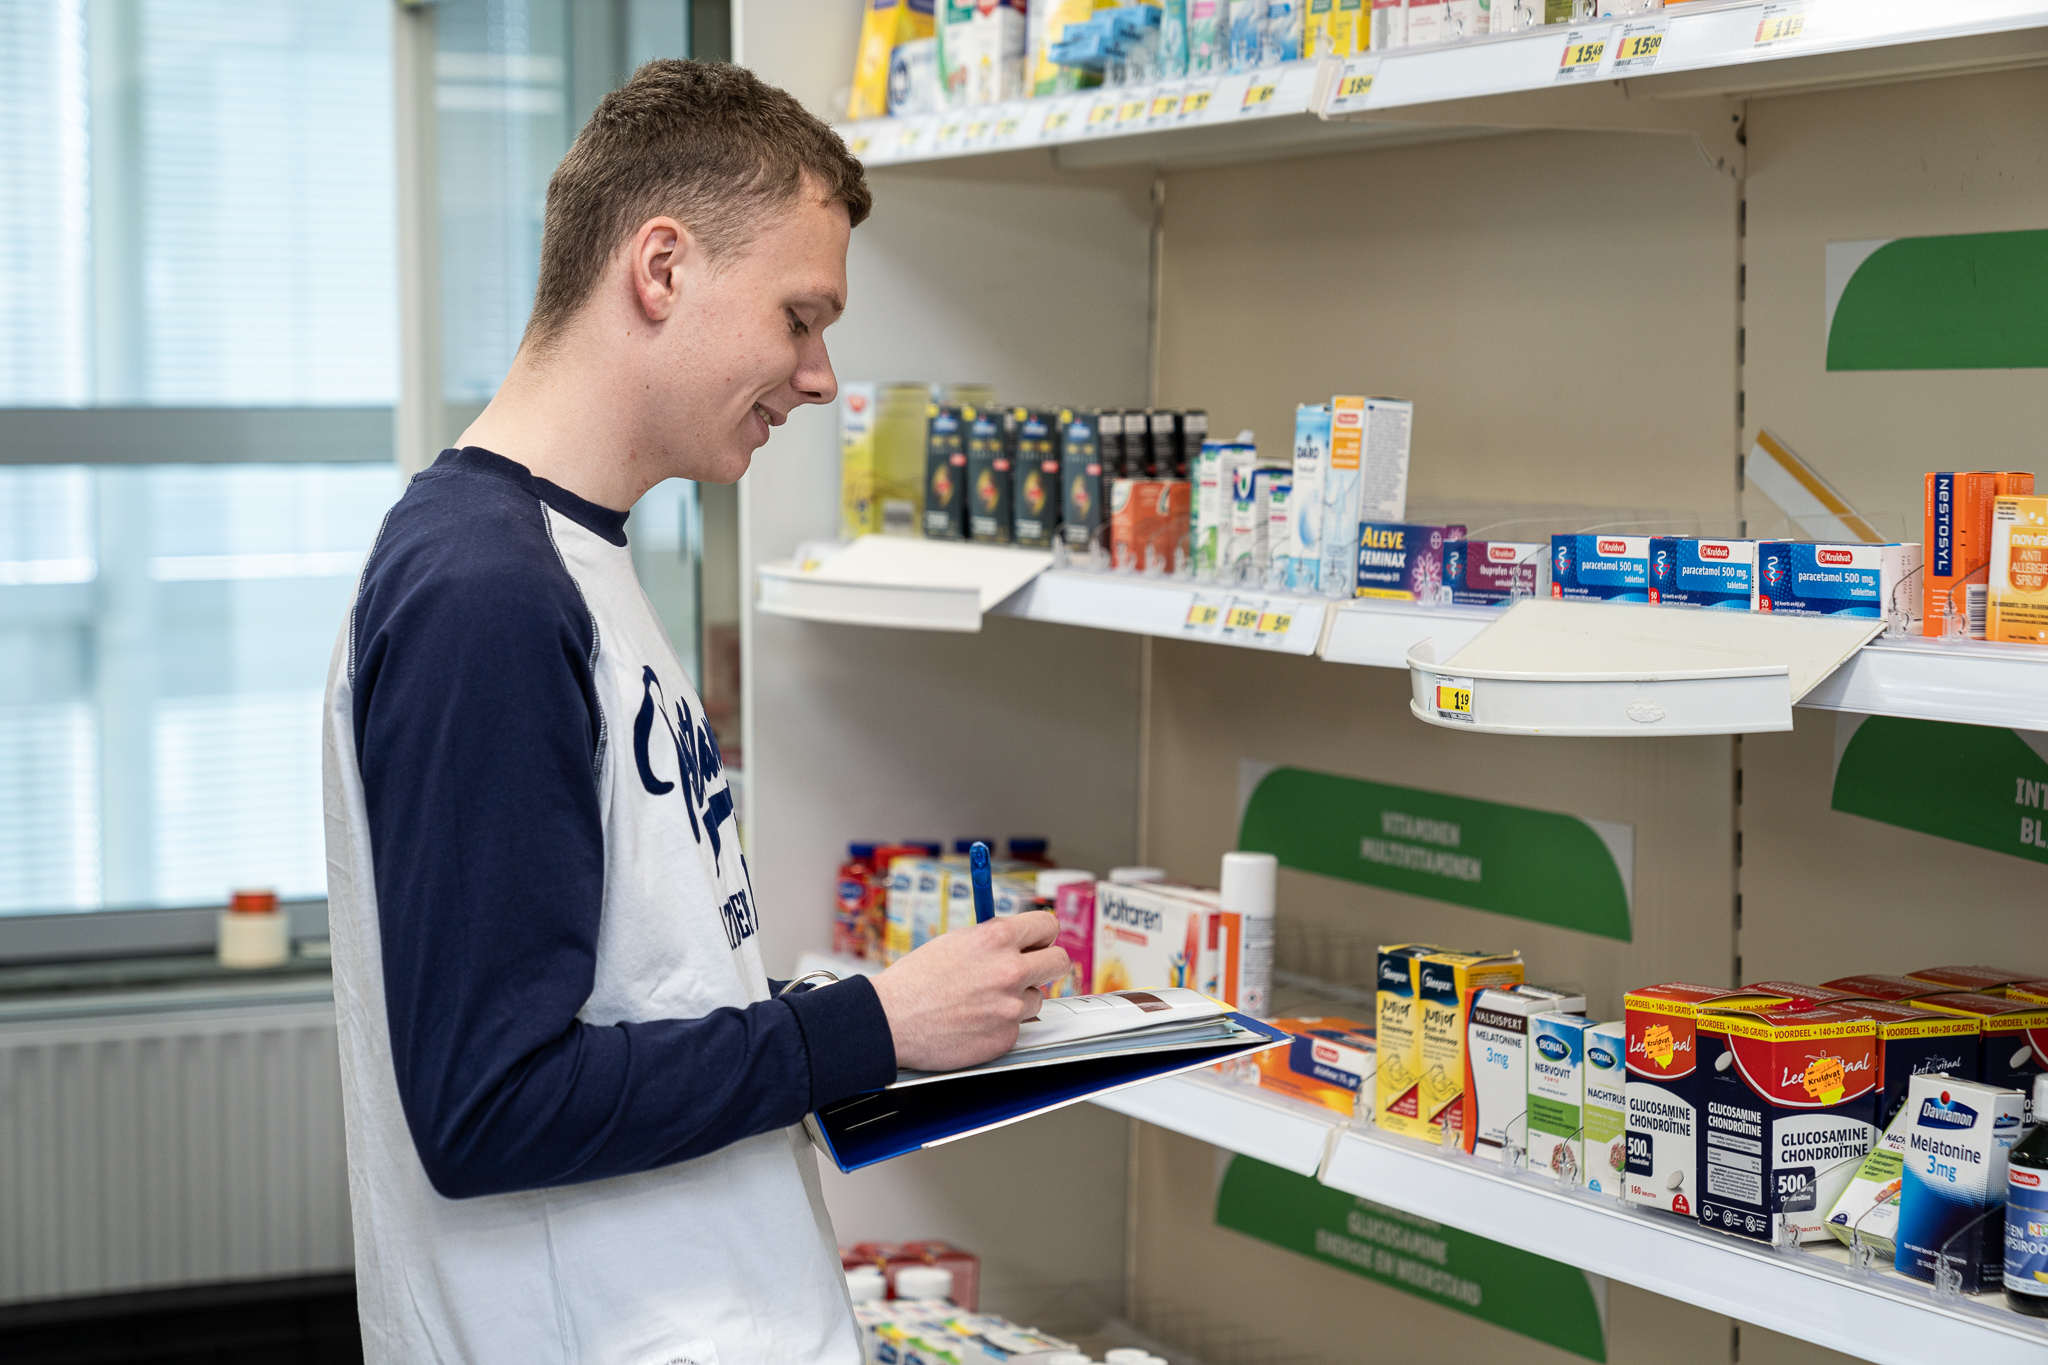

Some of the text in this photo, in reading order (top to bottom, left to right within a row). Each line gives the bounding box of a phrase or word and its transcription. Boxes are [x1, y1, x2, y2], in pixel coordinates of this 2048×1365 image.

[1575, 45, 1604, 63] 15.49
[1632, 37, 1662, 56] 15.00
[1297, 446, 1320, 460] DARO
[1361, 526, 1405, 550] ALEVE
[1495, 549, 1515, 559] Kruidvat
[1604, 543, 1625, 552] Kruidvat
[1707, 547, 1728, 557] Kruidvat
[2020, 550, 2041, 562] ANTI
[1360, 550, 1407, 568] FEMINAX
[1826, 552, 1851, 563] Kruidvat
[1480, 565, 1508, 577] Ibuprofen
[1523, 570, 1533, 580] mg,
[1582, 560, 1645, 573] paracetamol 500 mg,
[1682, 566, 1748, 580] paracetamol 500 mg,
[2011, 562, 2048, 575] ALLERGIE
[1624, 575, 1645, 583] tabletten
[1727, 581, 1748, 589] tabletten
[1798, 571, 1876, 586] paracetamol 500 mg,
[2016, 574, 2043, 587] SPRAY
[1651, 591, 1657, 599] 50
[1851, 588, 1877, 597] tabletten
[1761, 599, 1769, 607] 50
[1454, 691, 1470, 710] 1.19
[2015, 777, 2048, 811] INT
[1381, 810, 1461, 848] VITAMINEN
[2020, 816, 2048, 850] BL
[1360, 836, 1482, 883] MULTIVITAMINEN
[1100, 889, 1163, 934] Voltaren
[1625, 998, 1692, 1015] VOORDEEL 140+20 GRATIS
[1475, 1010, 1523, 1031] VALDISPERT
[1697, 1018, 1769, 1038] VOORDEEL 140+20 GRATIS
[1989, 1018, 2023, 1028] VOORDEEL
[1475, 1029, 1522, 1049] MELATONINE
[1774, 1025, 1870, 1039] VOORDEEL 140+20 GRATIS
[1886, 1024, 1975, 1037] VOORDEEL 140+20 GRATIS
[1539, 1038, 1565, 1054] BIONAL
[1647, 1037, 1670, 1047] Kruidvat
[1672, 1035, 1692, 1052] aal
[1486, 1047, 1509, 1070] 3mg
[1590, 1051, 1612, 1064] BIONAL
[1912, 1056, 1962, 1075] Leef vitaal
[1534, 1062, 1571, 1080] NERVOVIT
[1543, 1075, 1560, 1084] FORTE
[1808, 1069, 1841, 1086] Kruidvat
[1587, 1087, 1626, 1106] NACHTRUS
[1630, 1098, 1691, 1121] GLUCOSAMINE
[1708, 1101, 1762, 1124] GLUCOSAMINE
[1922, 1102, 1973, 1128] Davitamon
[1630, 1113, 1691, 1137] CHONDROÏTINE
[1708, 1114, 1762, 1138] CHONDROÏTINE
[1781, 1127, 1868, 1147] GLUCOSAMINE
[1627, 1137, 1648, 1158] 500
[1781, 1142, 1868, 1163] CHONDROÏTINE
[1910, 1133, 1982, 1164] Melatonine
[1926, 1155, 1958, 1183] 3mg
[1778, 1173, 1807, 1194] 500
[2012, 1173, 2038, 1185] Kruidvat
[1631, 1184, 1641, 1195] 160
[1678, 1196, 1683, 1204] 2
[1347, 1211, 1448, 1266] GLUCOSAMINE
[1797, 1226, 1822, 1234] ABLETTEN
